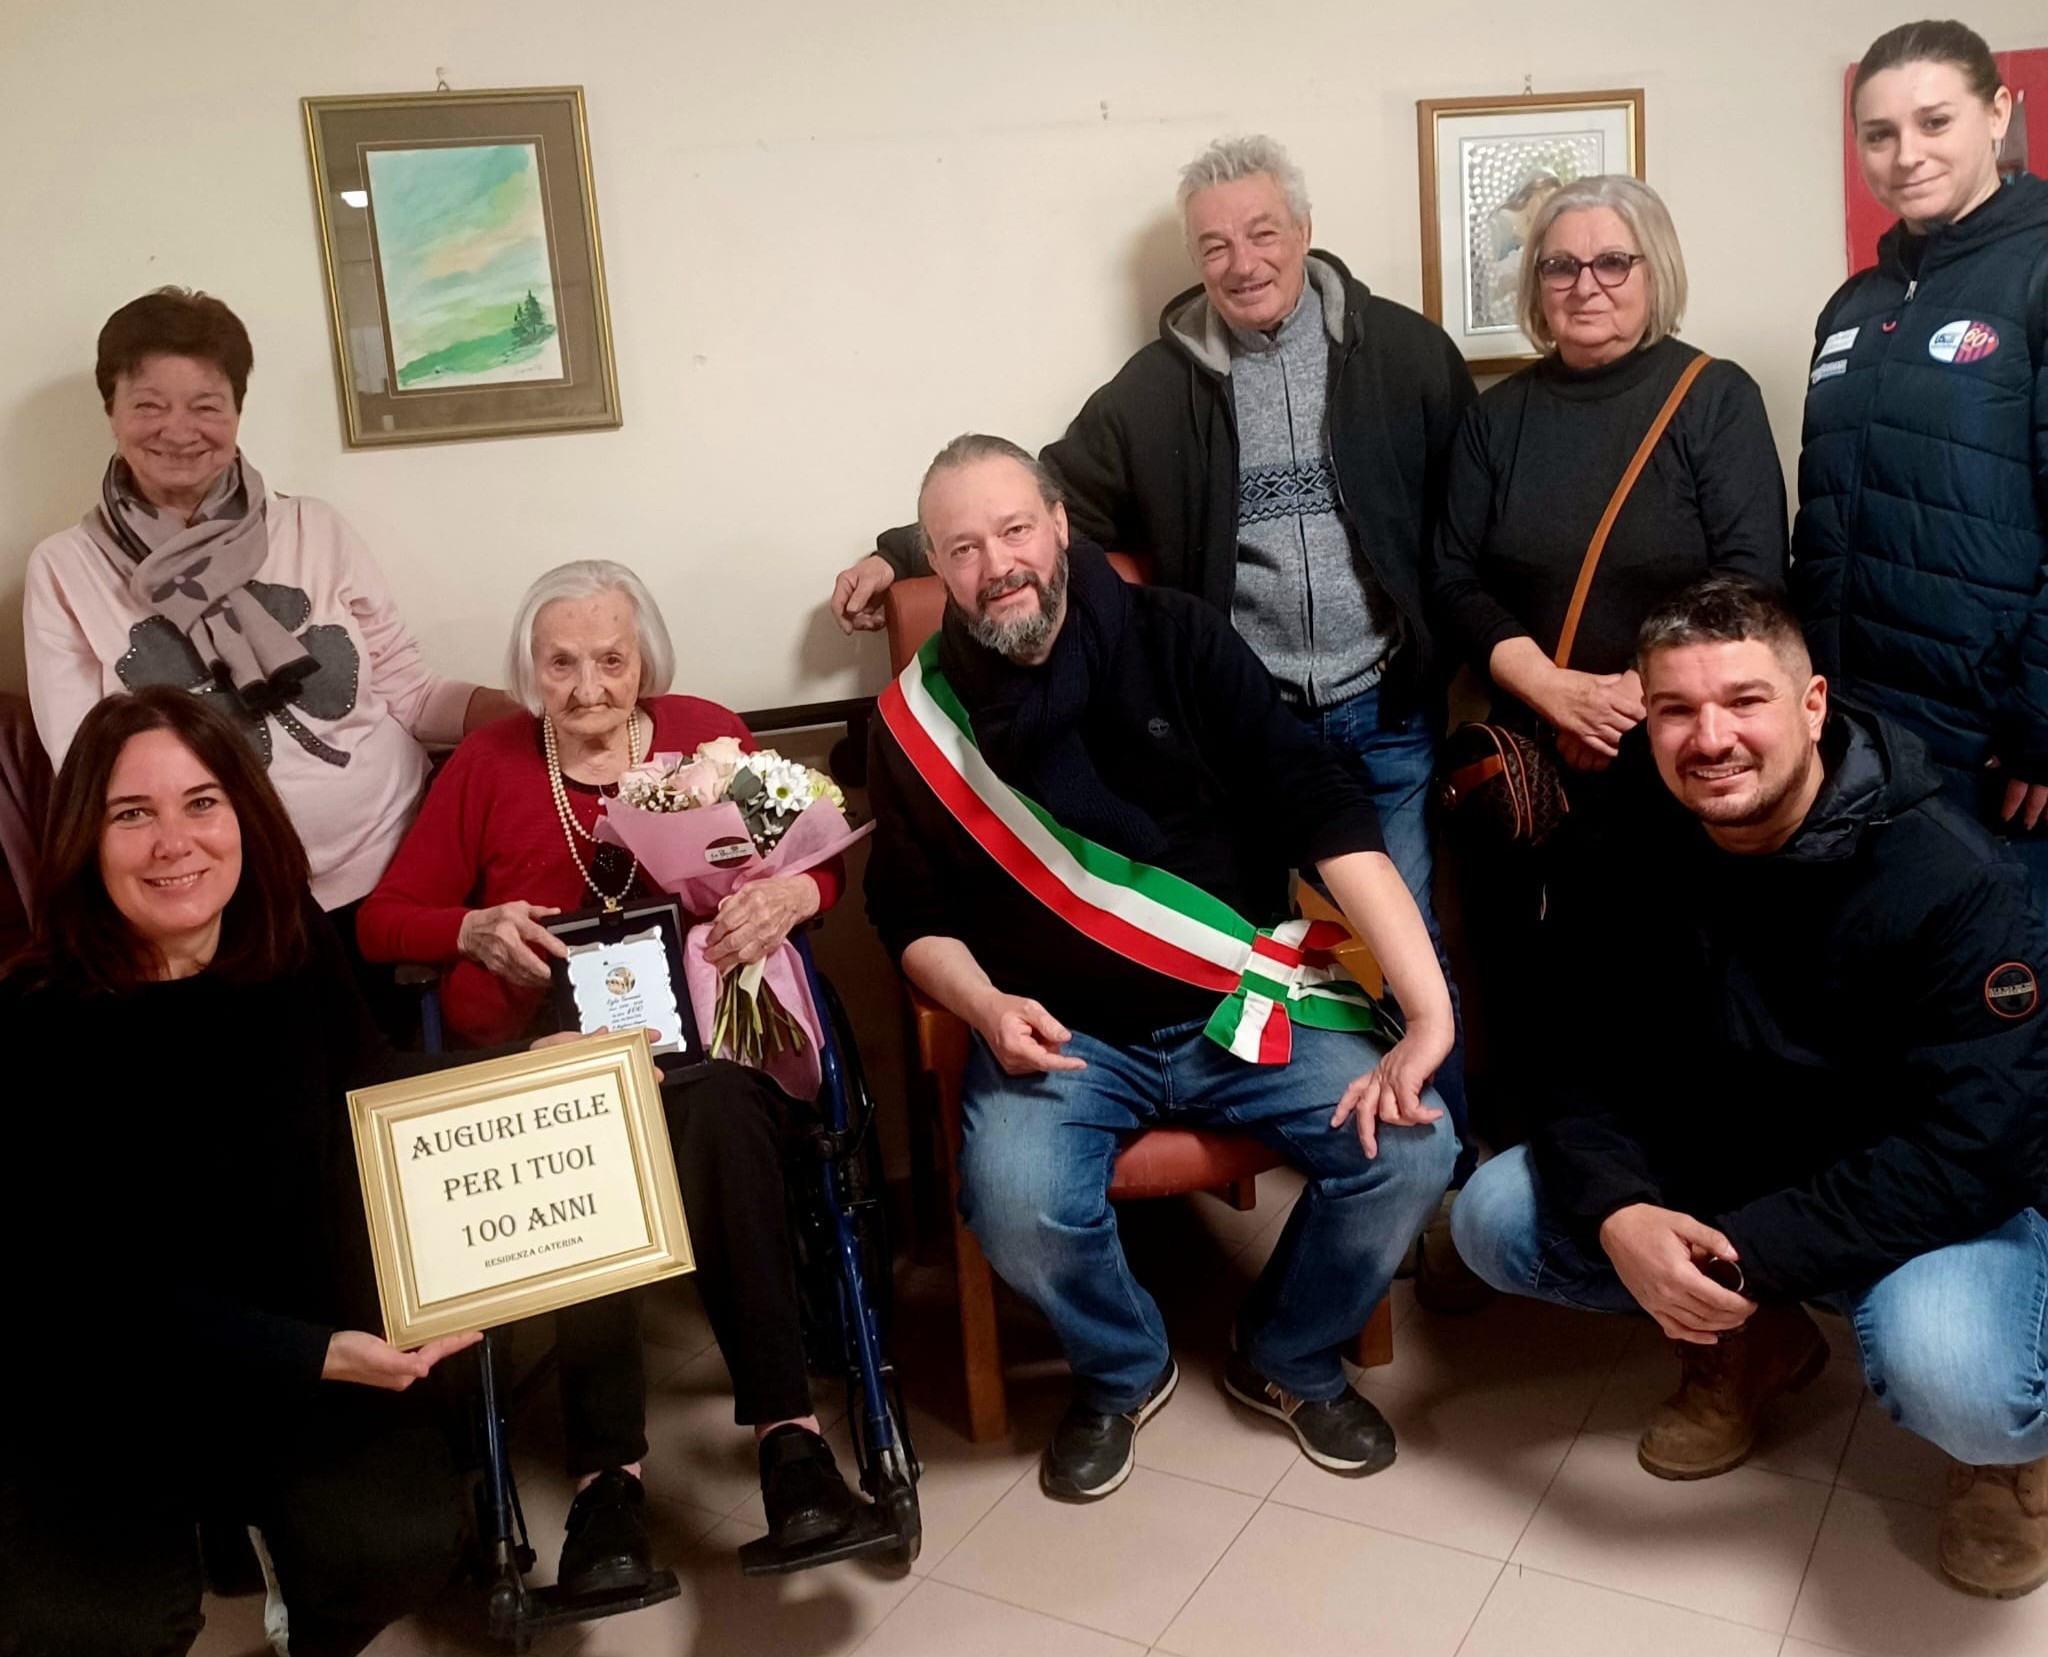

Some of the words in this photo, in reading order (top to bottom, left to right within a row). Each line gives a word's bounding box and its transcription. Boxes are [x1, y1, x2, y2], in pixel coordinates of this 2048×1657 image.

[411, 1112, 527, 1161] AUGURI
[533, 1093, 611, 1130] EGLE
[443, 1168, 504, 1202] PER
[511, 1162, 523, 1185] I
[526, 1144, 597, 1180] TUOI
[461, 1214, 517, 1248] 100
[527, 1192, 598, 1232] ANNI
[484, 1249, 537, 1268] RESIDENZA
[537, 1236, 584, 1254] CATERINA
